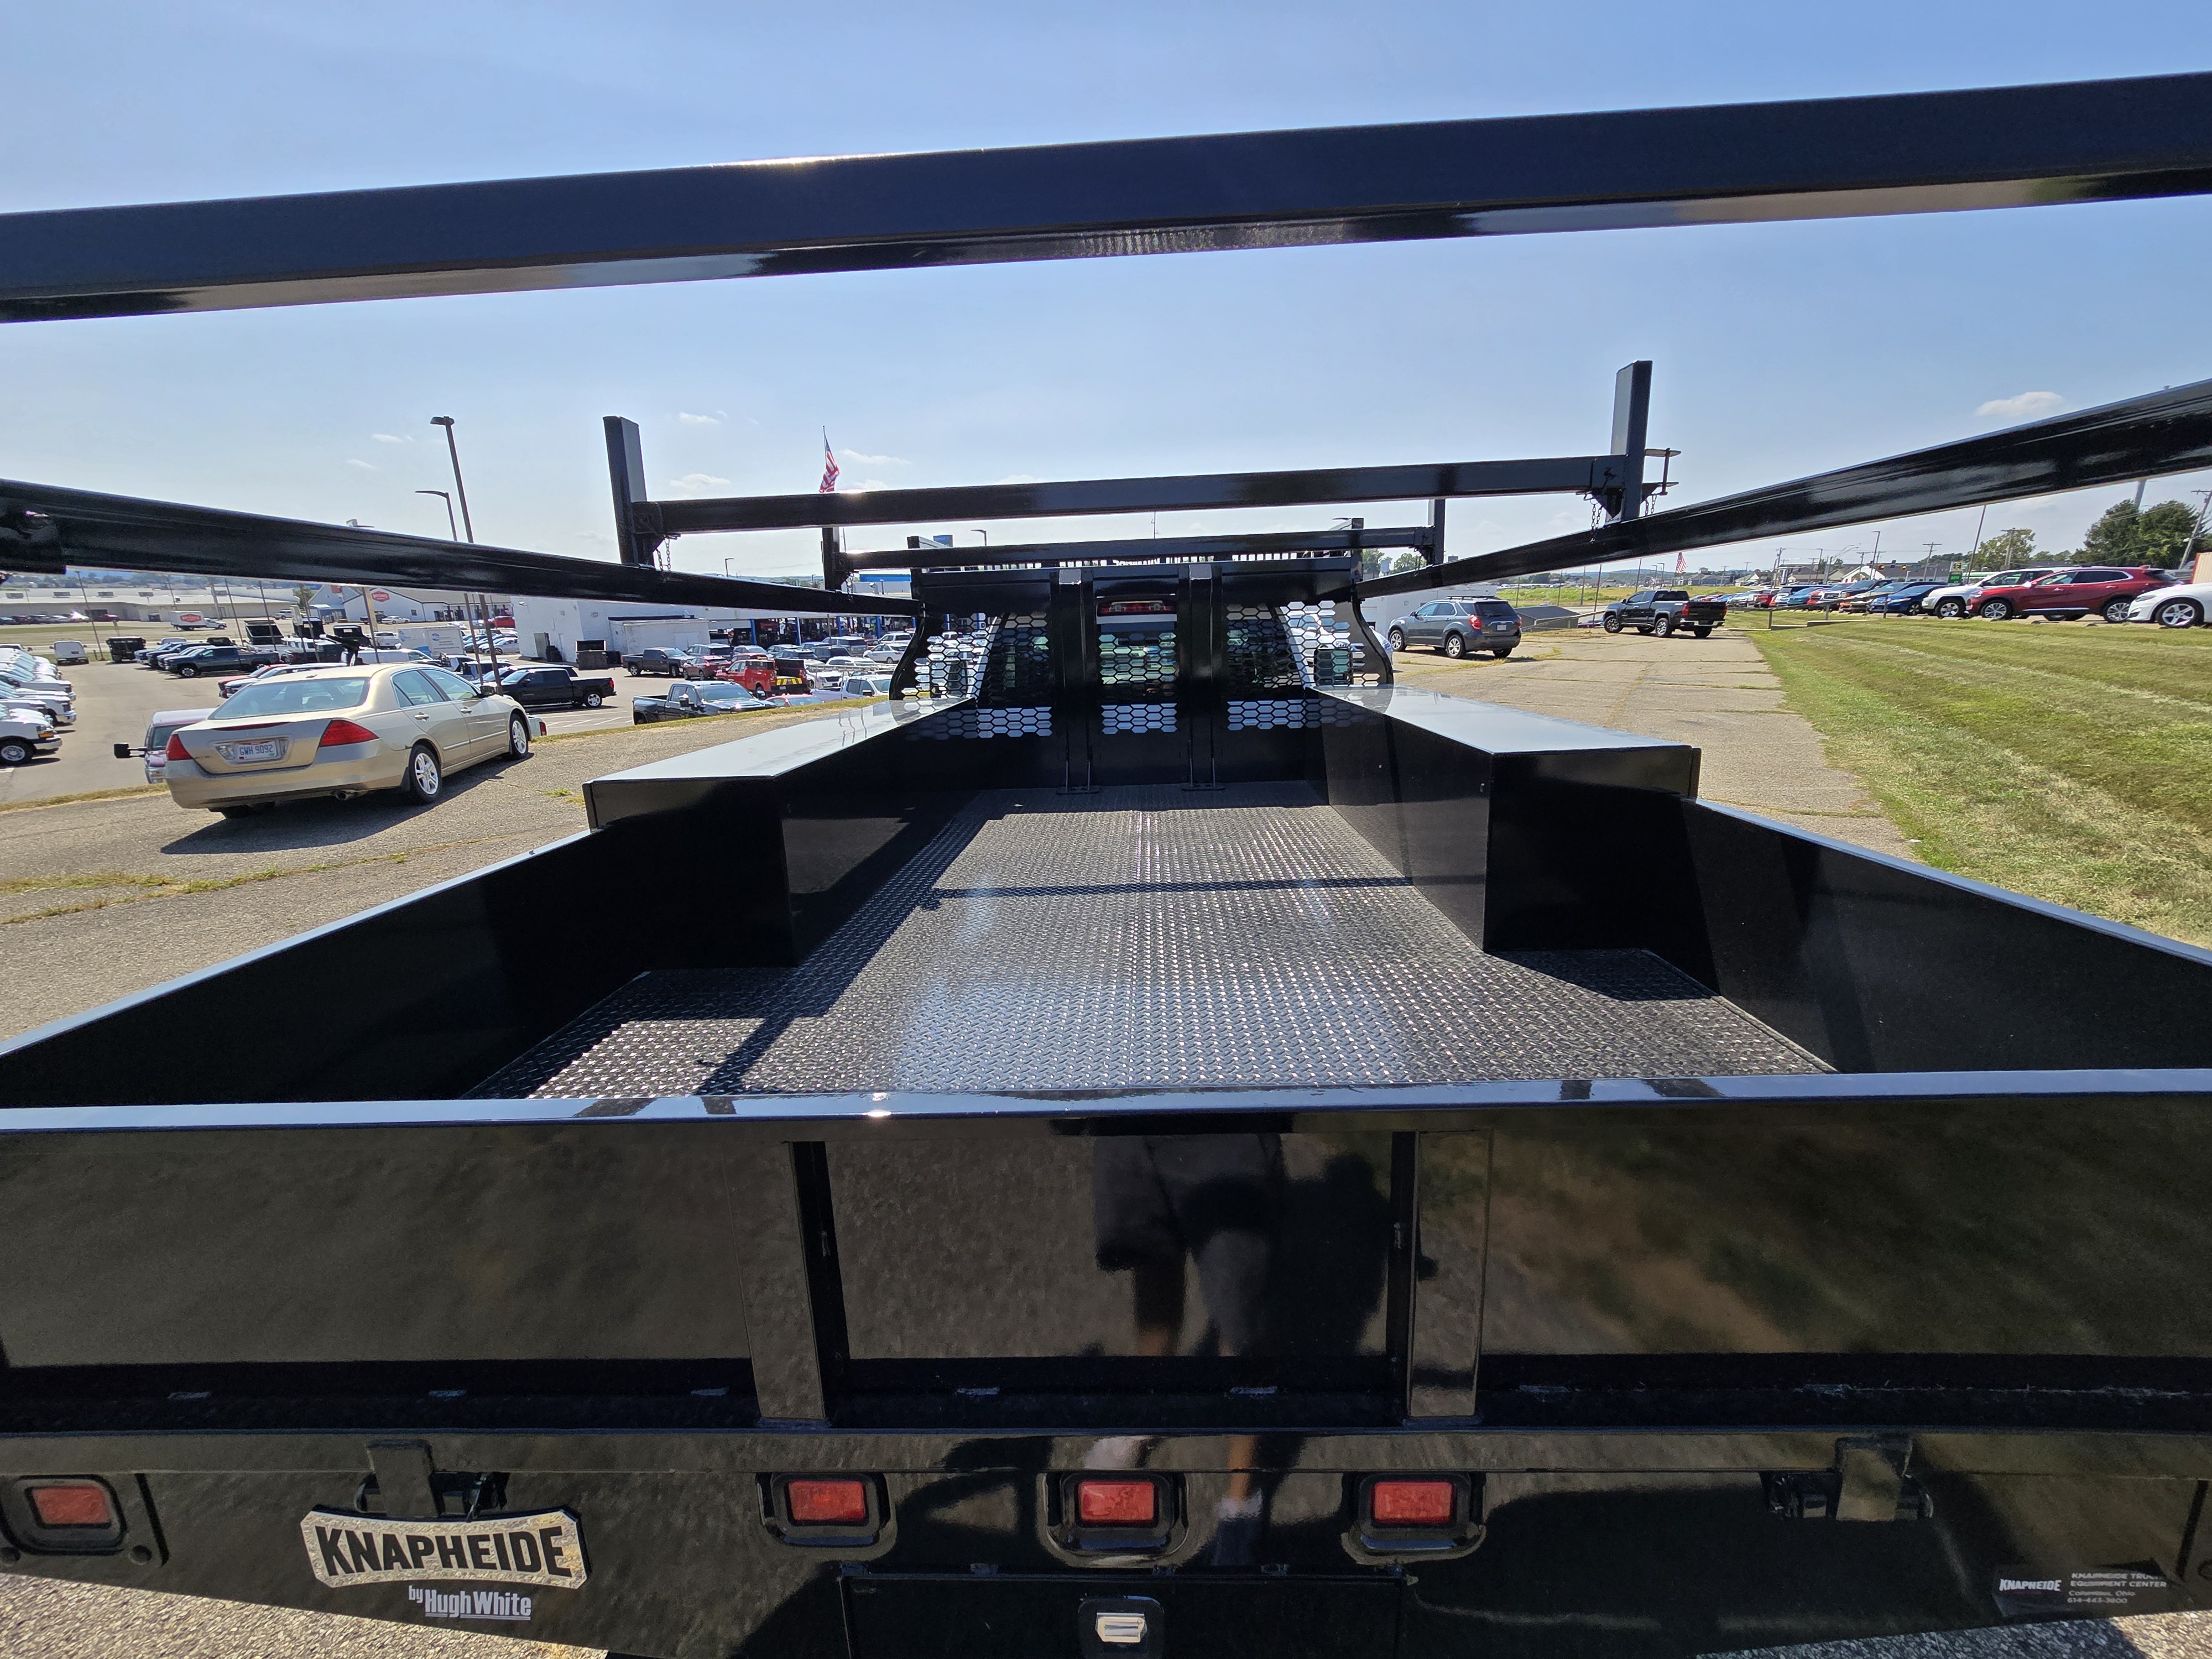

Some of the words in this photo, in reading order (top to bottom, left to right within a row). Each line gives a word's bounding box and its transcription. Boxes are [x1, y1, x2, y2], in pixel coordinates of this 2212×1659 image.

[239, 747, 254, 755] GWH
[255, 744, 274, 754] 9092
[315, 1525, 572, 1577] KNAPHEIDE
[1999, 1579, 2062, 1592] KNAPHEIDE
[409, 1585, 424, 1603] by
